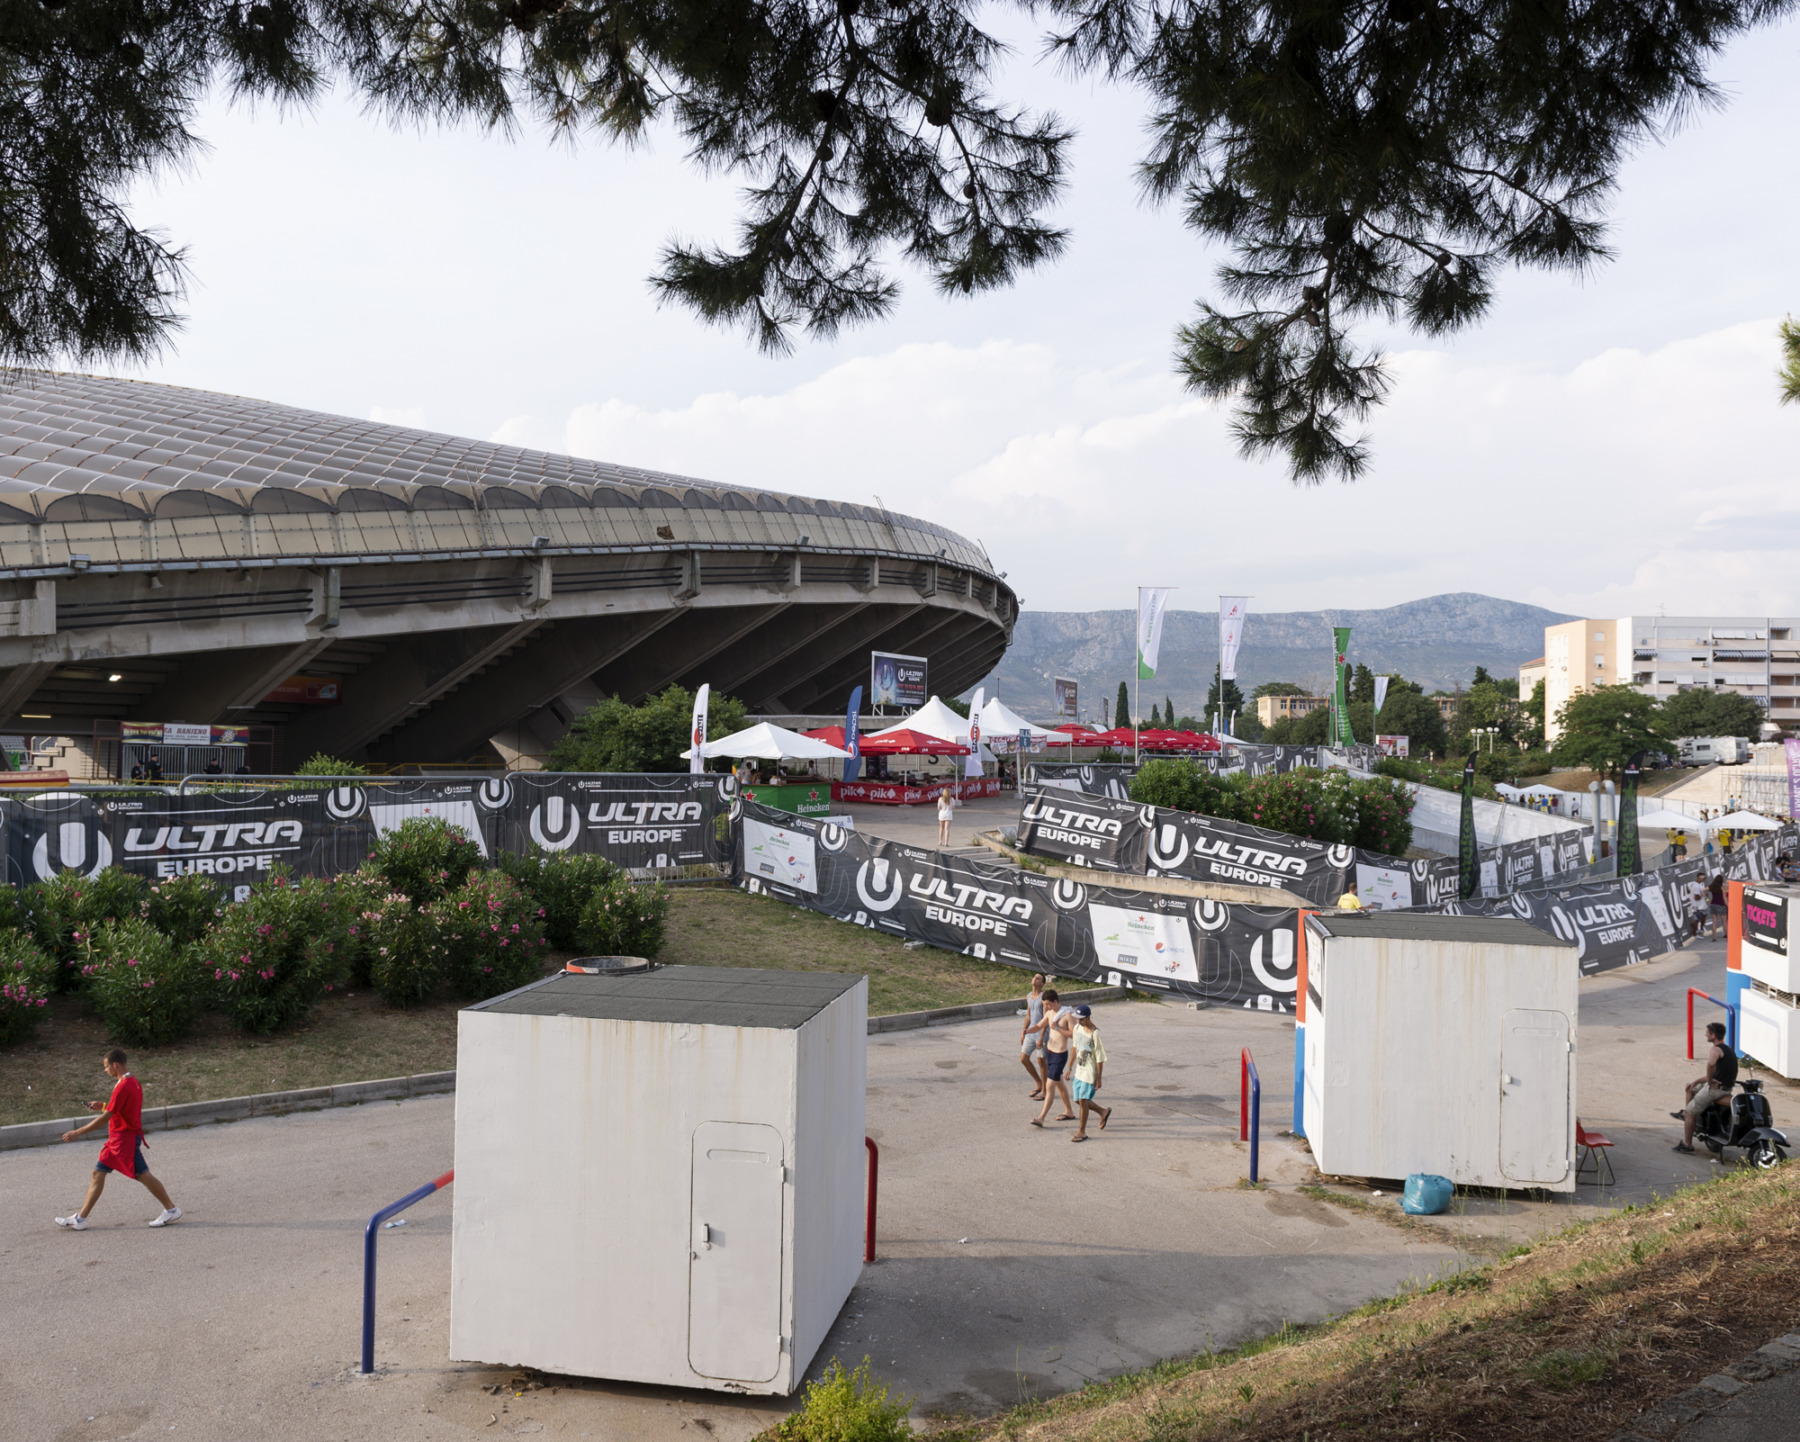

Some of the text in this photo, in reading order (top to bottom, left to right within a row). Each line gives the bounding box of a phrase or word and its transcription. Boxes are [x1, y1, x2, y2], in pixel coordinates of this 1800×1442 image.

[840, 785, 856, 798] pik
[870, 787, 888, 800] pik
[926, 787, 941, 800] pik
[966, 783, 977, 795] pik
[986, 781, 996, 794] pik
[905, 790, 917, 802] pik
[587, 801, 702, 824] ULTRA
[797, 803, 830, 814] Heineken
[1022, 803, 1123, 836] ULTRA
[124, 820, 304, 852] ULTRA
[1194, 836, 1308, 876] ULTRA
[1514, 855, 1534, 872] ULTRA
[909, 872, 1034, 920] ULTRA
[1576, 903, 1635, 927] ULTRA
[1746, 904, 1776, 928] TICKETS
[1128, 921, 1155, 931] Heineken
[1165, 964, 1176, 974] vip
